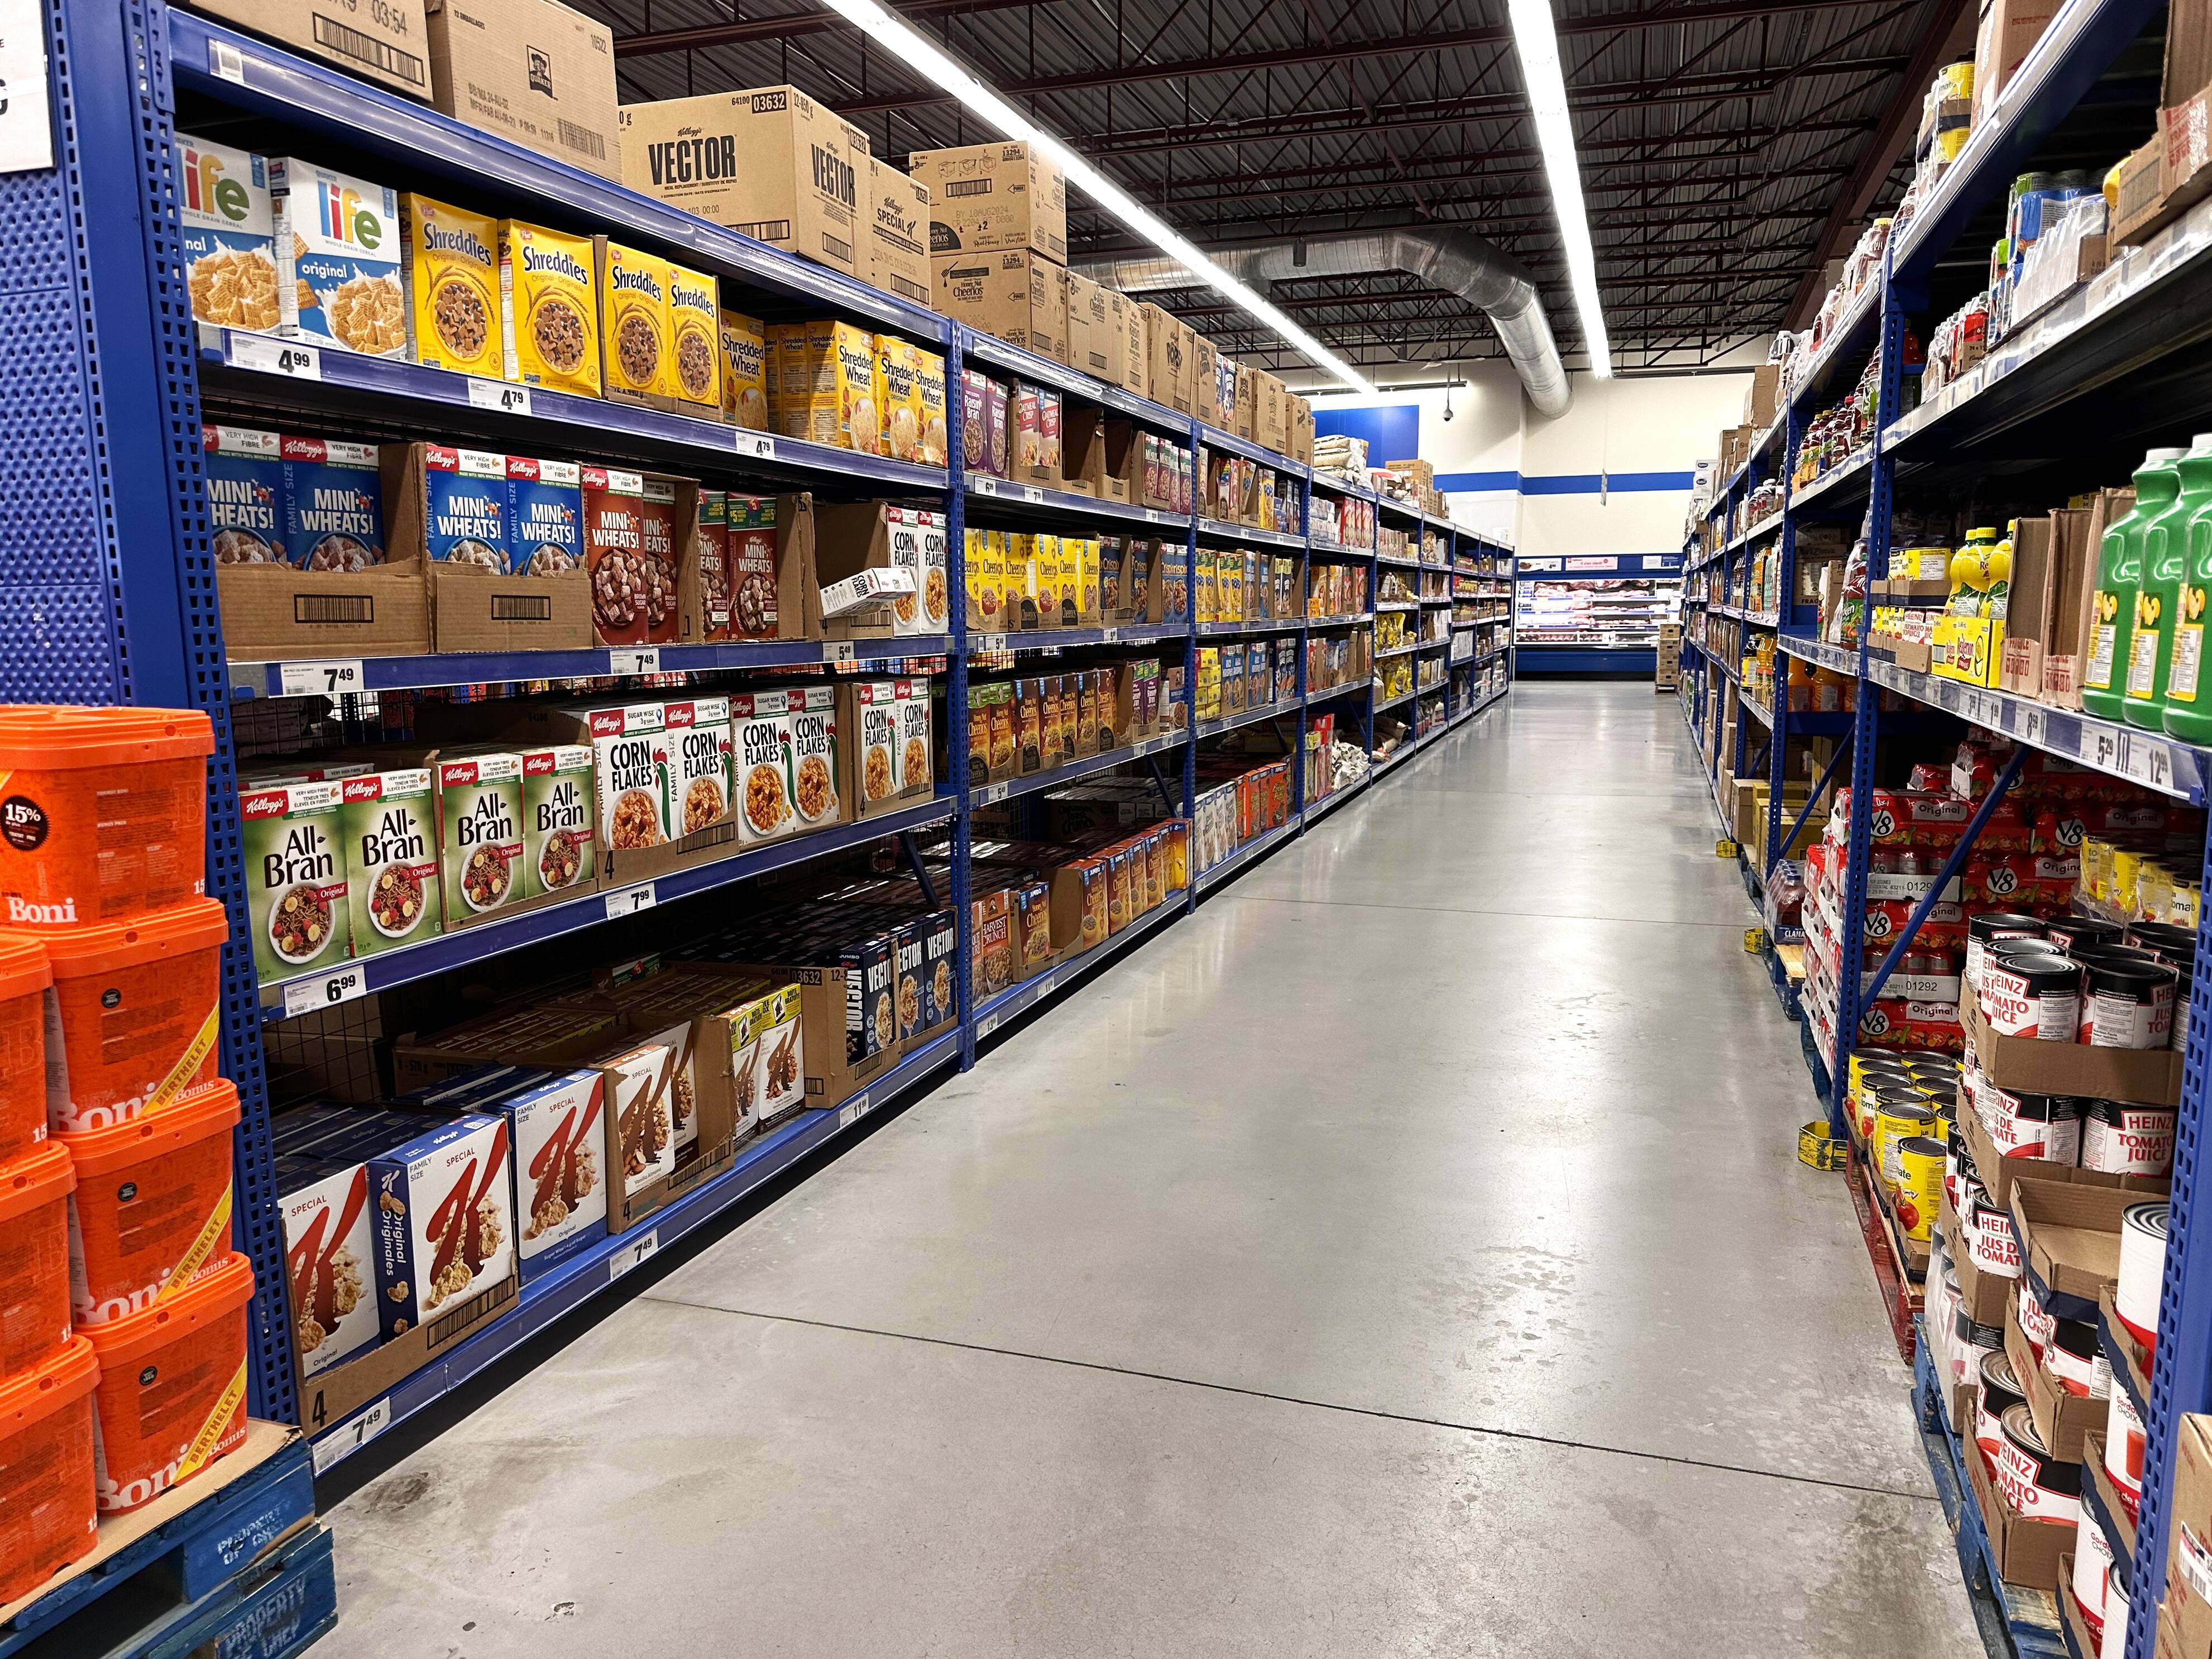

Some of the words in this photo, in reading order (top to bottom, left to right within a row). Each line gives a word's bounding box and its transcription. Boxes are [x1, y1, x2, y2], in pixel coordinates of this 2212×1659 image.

[372, 0, 408, 37] 03:54
[591, 34, 607, 54] 10522
[531, 74, 551, 89] QUAKER
[731, 95, 750, 106] 64100
[753, 93, 786, 112] 03632
[850, 130, 865, 152] 03632
[648, 135, 737, 186] VECTOR
[318, 180, 382, 250] life
[877, 208, 906, 233] SPECIAL
[907, 220, 916, 240] K
[983, 221, 988, 230] 2
[423, 223, 492, 267] Shreddies
[302, 263, 347, 279] original
[523, 246, 588, 285] Shreddies
[671, 284, 715, 318] Shreddies
[954, 286, 983, 297] Cheerios
[722, 332, 764, 360] Shredded
[808, 334, 835, 343] Shredded
[812, 341, 831, 349] Wheat
[729, 352, 760, 376] Wheat
[735, 372, 758, 383] ORIGINAL
[916, 370, 945, 392] Shredded
[920, 388, 942, 407] Wheat
[964, 395, 981, 409] Raisin
[1019, 400, 1036, 413] OATMEAL
[967, 408, 979, 420] Bran
[1023, 410, 1033, 422] CRISP
[242, 440, 260, 449] FIBRE
[285, 439, 323, 457] Kellogg's
[285, 463, 294, 490] SIZE
[510, 461, 539, 477] Kellogg's
[287, 493, 297, 534] FAMILY
[300, 510, 374, 534] WHEATS!
[521, 522, 576, 544] WHEATS!
[592, 528, 640, 549] WHEATS!
[894, 531, 915, 552] CORN
[738, 558, 773, 573] WHEATS!
[894, 550, 916, 567] FLAKES
[983, 559, 1004, 575] Cheerios
[1040, 562, 1058, 577] Cheerios
[1084, 562, 1099, 576] Cheerios
[1020, 705, 1037, 719] Cheerios
[1043, 701, 1059, 715] Cheerios
[593, 717, 621, 733] Kellogg's
[796, 716, 825, 740] CORN
[610, 740, 650, 770] CORN
[682, 732, 717, 759] CORN
[797, 737, 826, 757] FLAKES
[683, 754, 719, 780] FLAKES
[612, 764, 652, 791] FLAKES
[5, 803, 41, 823] 15%
[246, 797, 285, 814] Kellogg's
[1918, 803, 1961, 817] Original
[537, 803, 584, 832] Bran
[574, 832, 591, 842] Original
[264, 851, 333, 888] Bran
[605, 852, 614, 879] 4
[1988, 867, 2014, 891] V8
[320, 885, 345, 900] Original
[1030, 888, 1042, 898] JUMBO
[8, 897, 79, 924] Boni
[1026, 911, 1047, 928] Cheerios
[982, 916, 1007, 935] HARVEST
[927, 927, 954, 960] VECTOR
[982, 929, 1007, 946] CRUNCH
[792, 970, 822, 985] 03632
[1905, 980, 1938, 992] 01292
[1995, 974, 2023, 995] EINZ
[846, 969, 863, 1031] VECTOR
[1912, 1004, 1954, 1016] Original
[1992, 1005, 2017, 1025] UICE
[1863, 1013, 1885, 1032] V8
[155, 1038, 207, 1105] BERTHELET
[631, 1065, 652, 1080] SPECIAL
[172, 1078, 215, 1103] Bonus
[549, 1096, 576, 1113] SPECIAL
[2128, 1115, 2172, 1130] HEINZ
[1920, 1129, 1929, 1139] jus
[2119, 1134, 2173, 1149] TOMATO
[446, 1148, 476, 1167] SPECIAL
[2128, 1148, 2166, 1162] JUICE
[410, 1157, 432, 1173] FAMILY
[410, 1170, 424, 1182] SIZE
[558, 1224, 577, 1238] Original
[1981, 1236, 2003, 1252] JUS
[1977, 1246, 2021, 1267] TOMAT
[313, 1349, 338, 1367] Original
[312, 1389, 327, 1428] 4
[2117, 1405, 2138, 1424] CHOIX
[189, 1389, 238, 1465] BERTHELET
